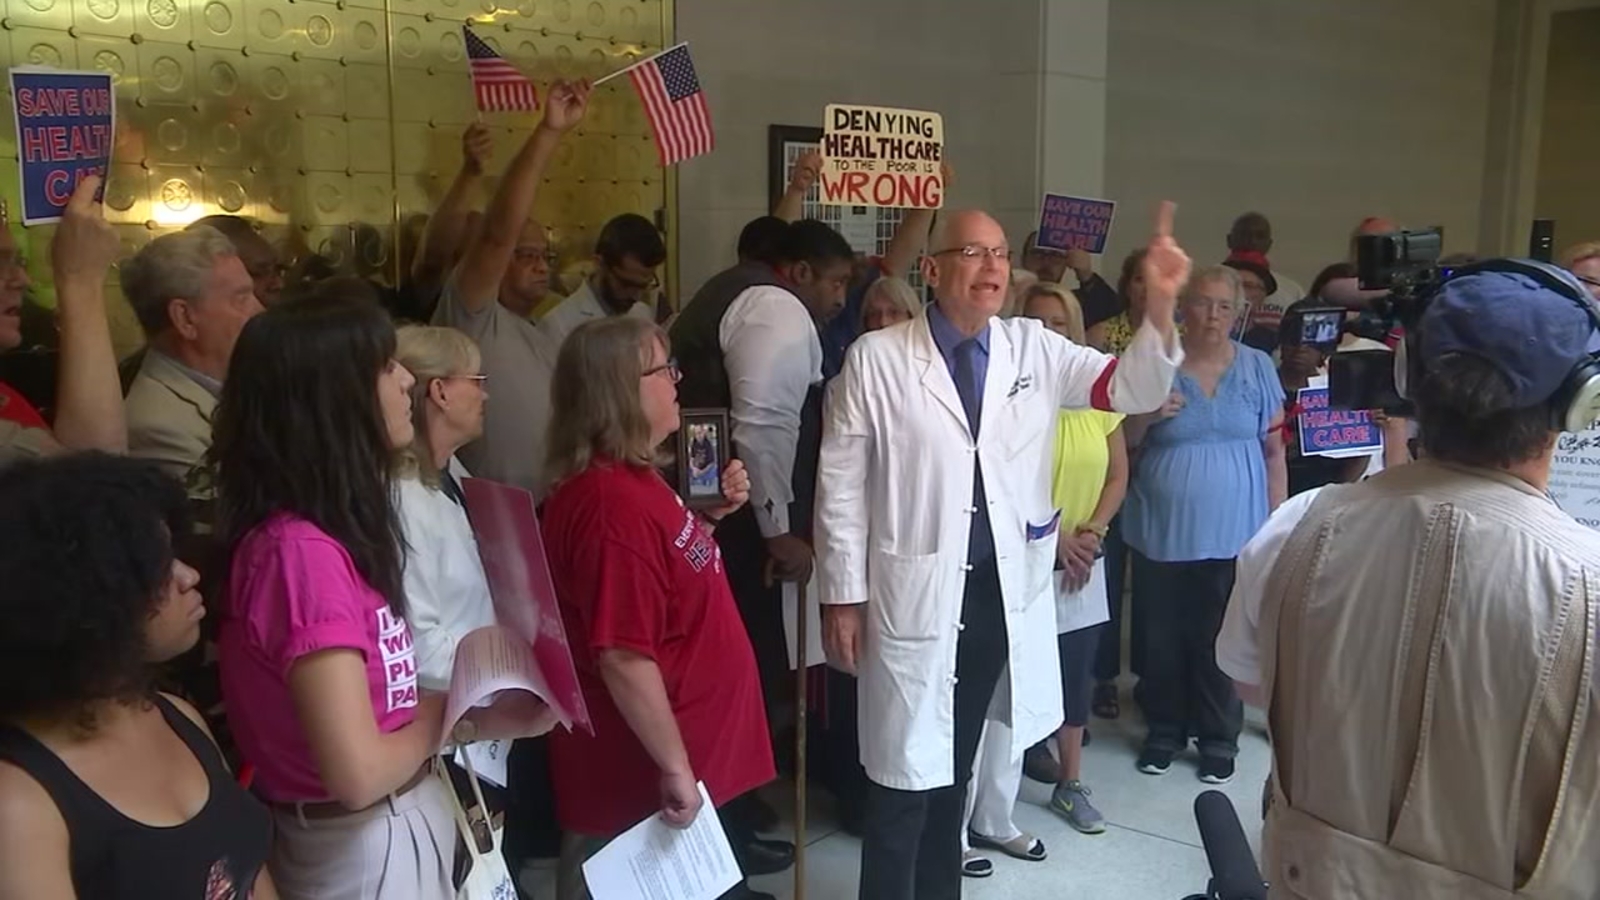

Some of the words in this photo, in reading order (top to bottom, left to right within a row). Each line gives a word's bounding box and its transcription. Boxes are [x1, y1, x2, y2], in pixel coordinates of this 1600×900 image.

[18, 88, 81, 117] SAVE
[834, 108, 933, 138] DENYING
[825, 133, 940, 162] HEALTHCARE
[833, 159, 850, 171] TO
[855, 159, 876, 171] THE
[886, 160, 917, 172] POOR
[924, 163, 933, 173] IS
[820, 172, 940, 208] WRONG
[1301, 394, 1329, 409] SAV
[1313, 426, 1371, 447] CARE
